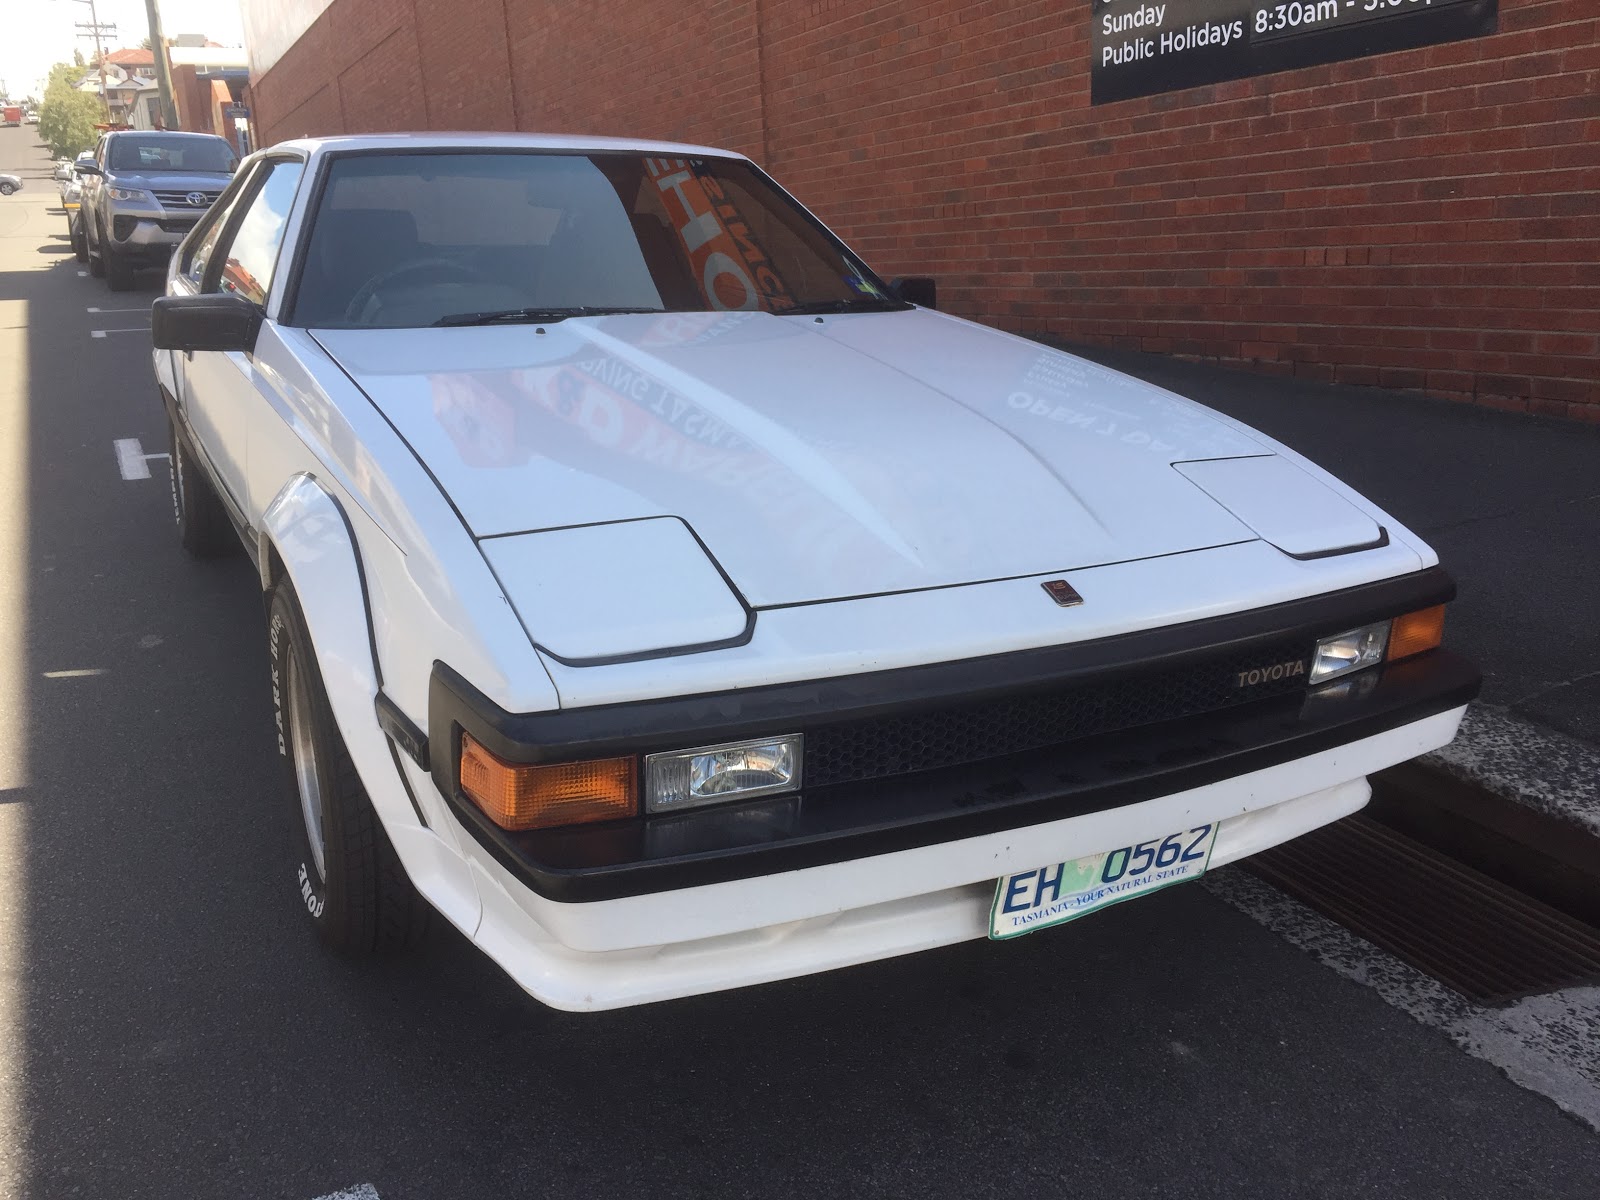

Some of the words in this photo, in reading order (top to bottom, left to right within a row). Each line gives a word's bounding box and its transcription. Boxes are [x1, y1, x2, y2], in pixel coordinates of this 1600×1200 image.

[1102, 4, 1166, 35] Sunday
[1102, 38, 1154, 67] Public
[1160, 20, 1243, 55] Holidays
[1254, 0, 1338, 33] 8:30am
[1238, 660, 1304, 687] TOYOTA
[1001, 862, 1066, 915] EH
[1100, 823, 1212, 884] 0562
[1012, 901, 1069, 926] TASMANIA
[1075, 889, 1105, 906] YOUR
[1105, 875, 1154, 896] NATURAL
[1155, 864, 1189, 881] STATE
